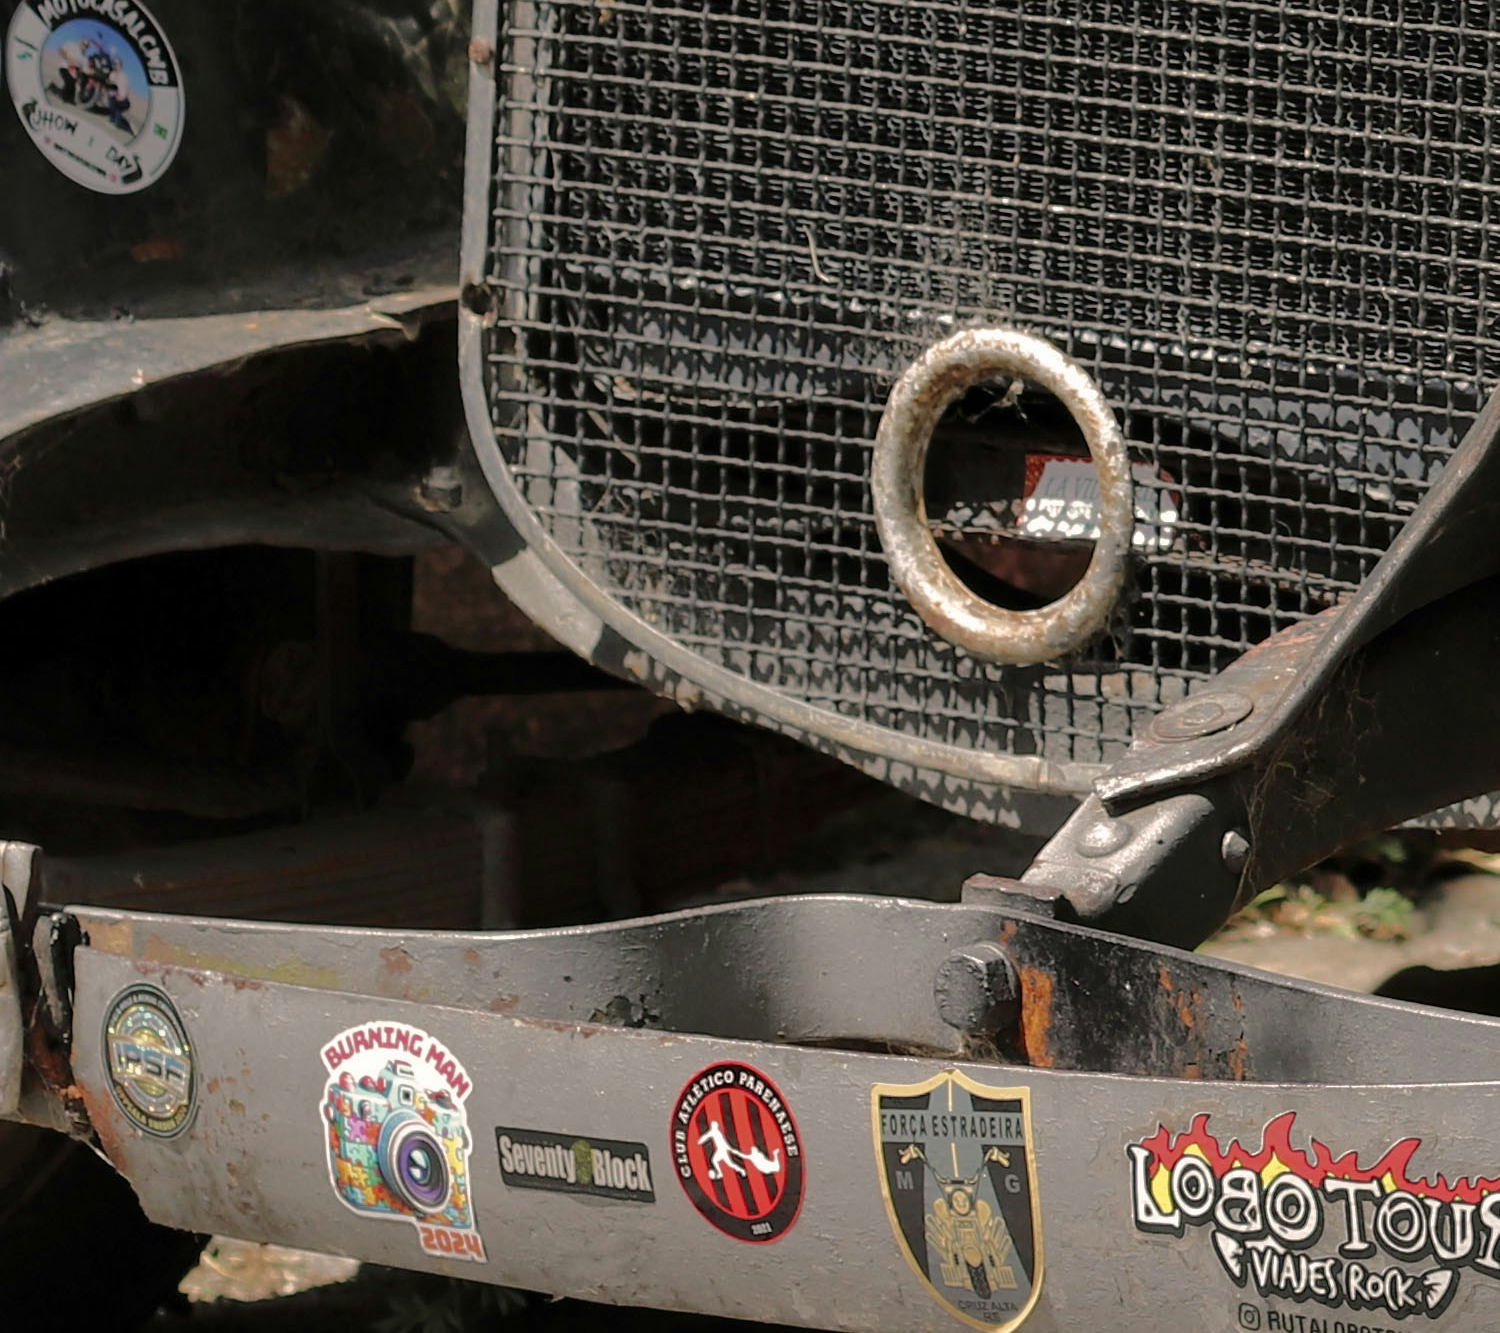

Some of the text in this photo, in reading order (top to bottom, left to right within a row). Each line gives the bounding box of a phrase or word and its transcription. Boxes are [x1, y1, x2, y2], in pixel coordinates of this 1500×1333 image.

[324, 1026, 469, 1098] BURNING MAN
[678, 1071, 735, 1124] ATLÉTICO
[881, 1113, 1023, 1142] FORÇA ESTRADEIRA
[500, 1134, 652, 1193] Seventy Block
[675, 1131, 692, 1178] CLUB
[1129, 1145, 1319, 1243] LOBO
[420, 1226, 484, 1258] 2024
[957, 1299, 1019, 1312] CRUZ ALTA
